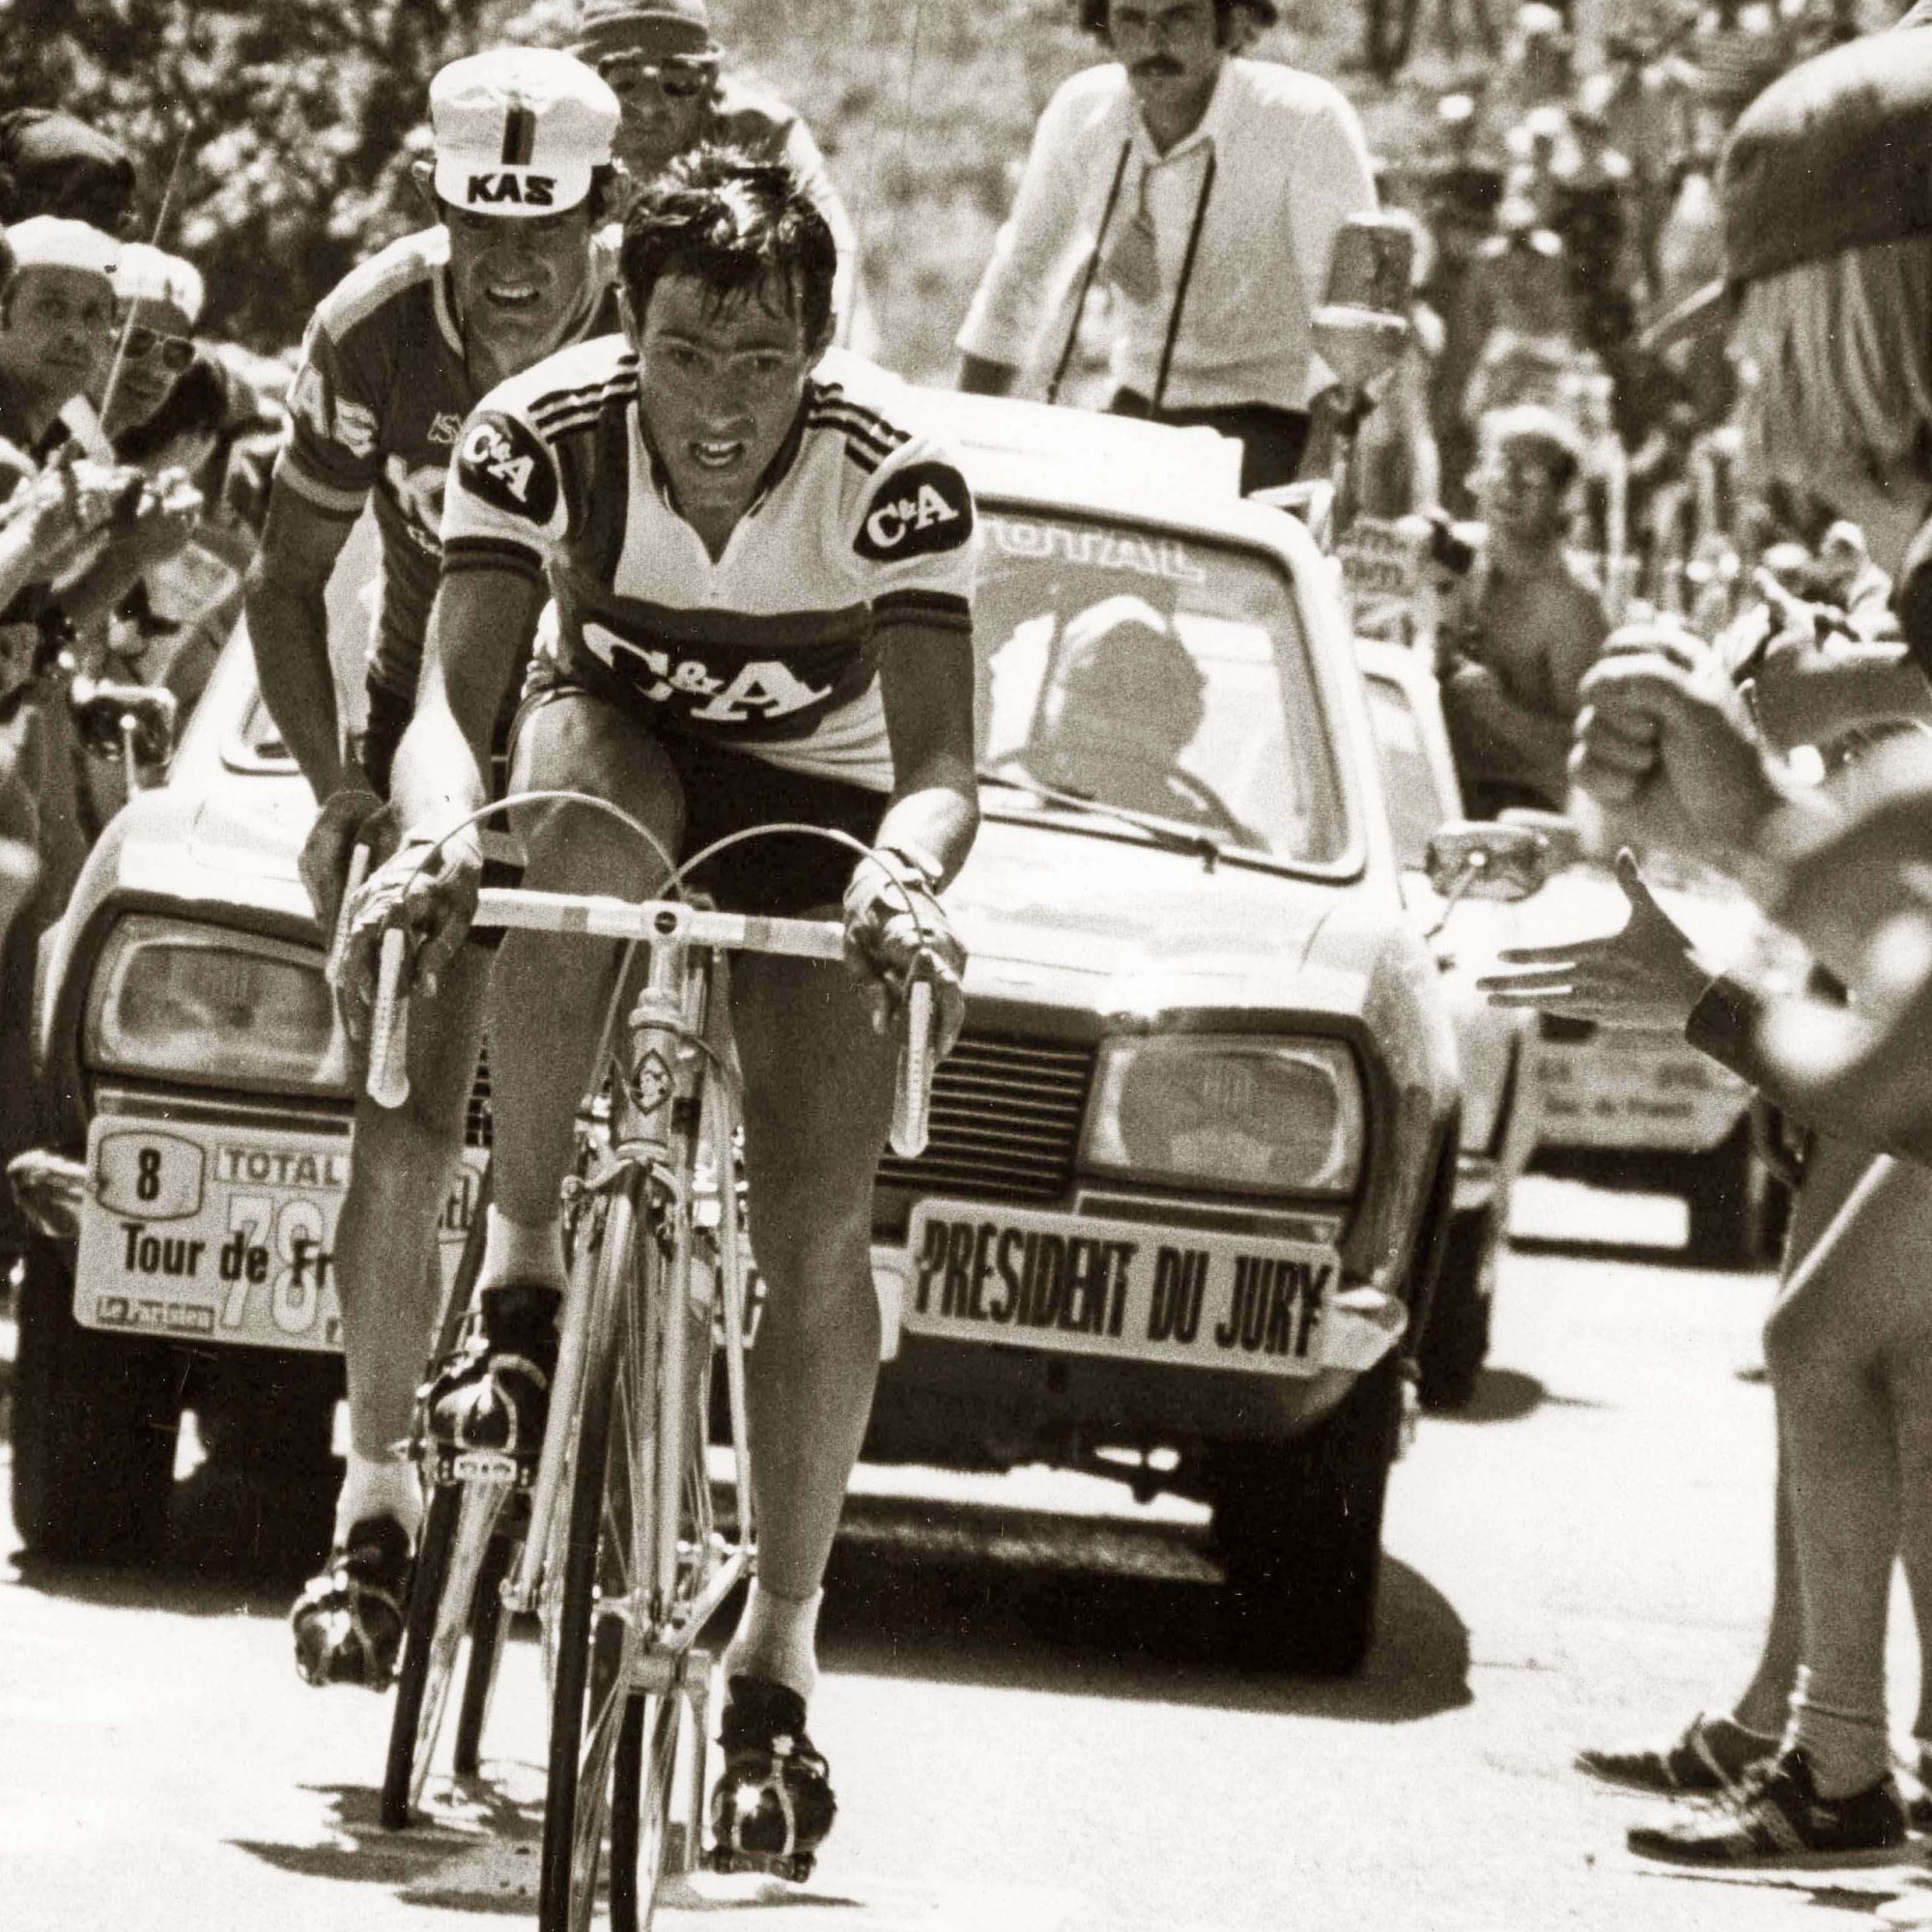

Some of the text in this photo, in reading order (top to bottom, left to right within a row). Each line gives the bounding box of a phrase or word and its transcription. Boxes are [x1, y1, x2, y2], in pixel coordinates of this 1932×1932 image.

[468, 173, 558, 206] KAS
[462, 422, 537, 504] C&A
[865, 482, 956, 548] C&A
[134, 1147, 162, 1203] 8
[224, 1147, 346, 1186] TOTAL
[121, 1221, 205, 1277] Tour
[218, 1231, 270, 1284] de
[914, 1218, 1333, 1358] PRESIDENT DU JURY
